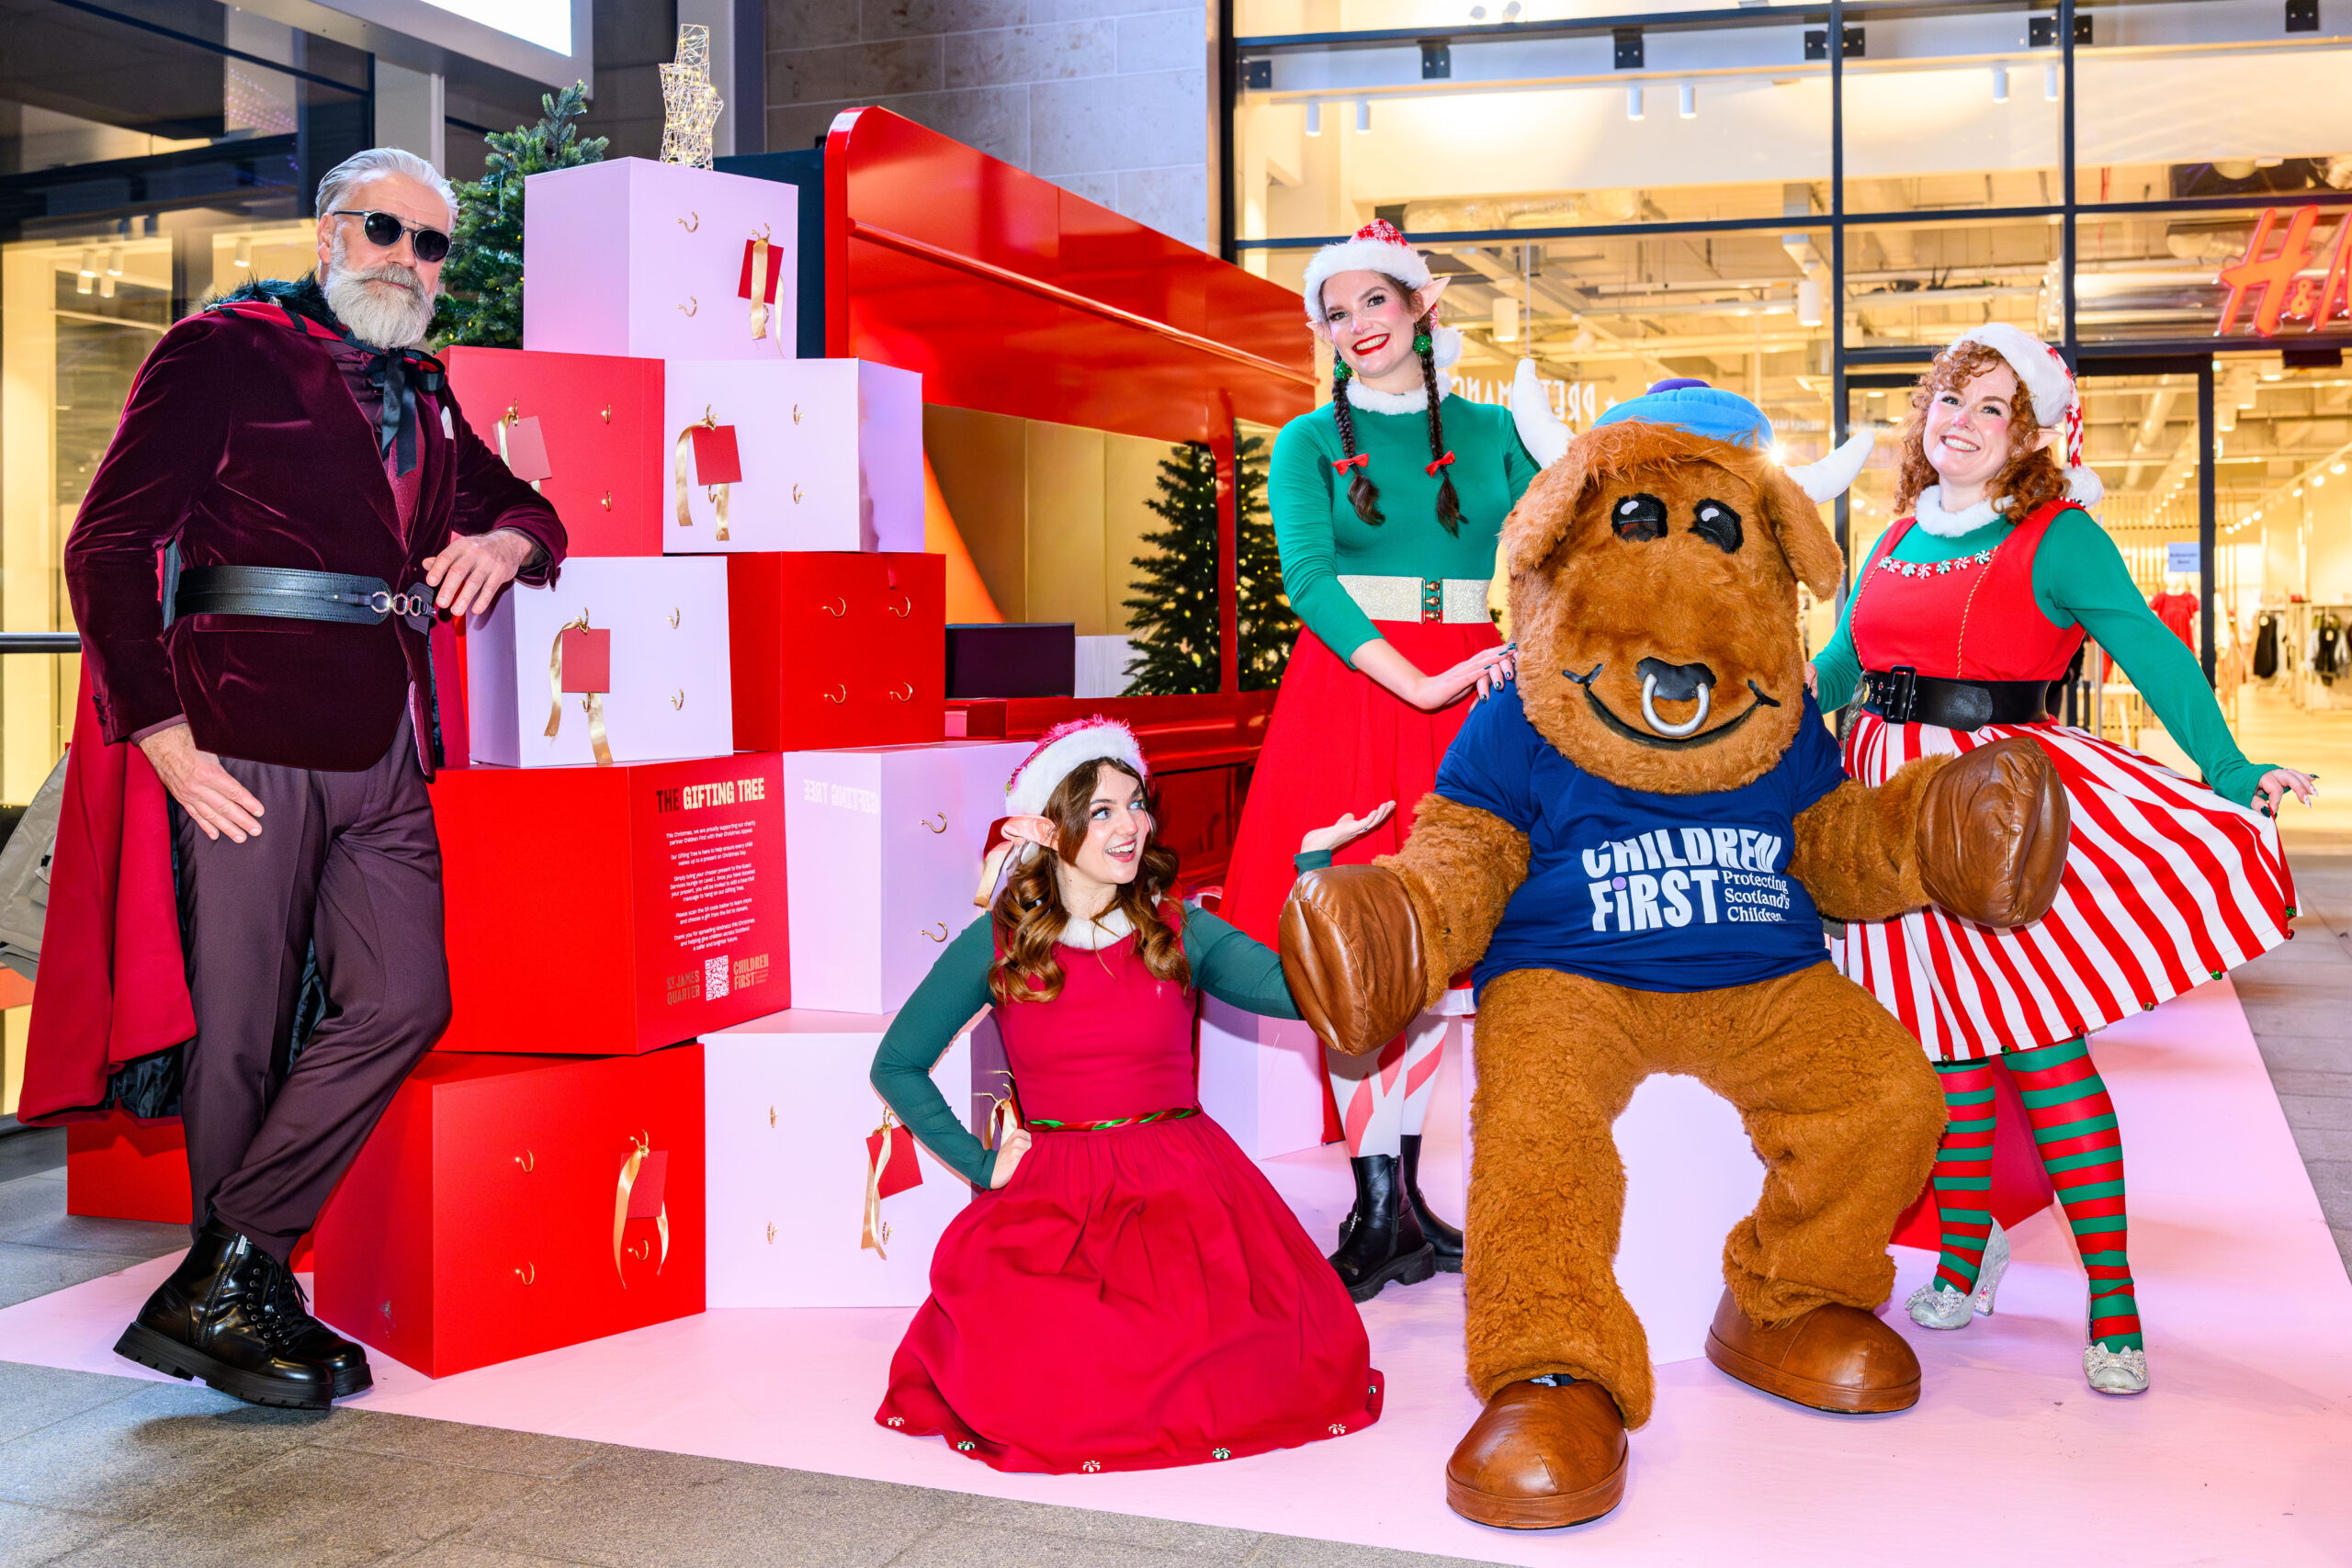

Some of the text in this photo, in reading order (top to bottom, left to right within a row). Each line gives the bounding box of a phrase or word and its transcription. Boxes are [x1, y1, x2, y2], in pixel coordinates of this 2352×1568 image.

[656, 777, 765, 813] THE GIFTING TREE
[1582, 828, 1781, 878] CHILDREN
[1721, 870, 1789, 894] Protecting
[1724, 887, 1790, 909] Scotland's
[1727, 906, 1787, 921] Children
[733, 953, 769, 976] CHILDREN
[676, 970, 699, 987] JAMES
[667, 984, 700, 1006] QUARTER
